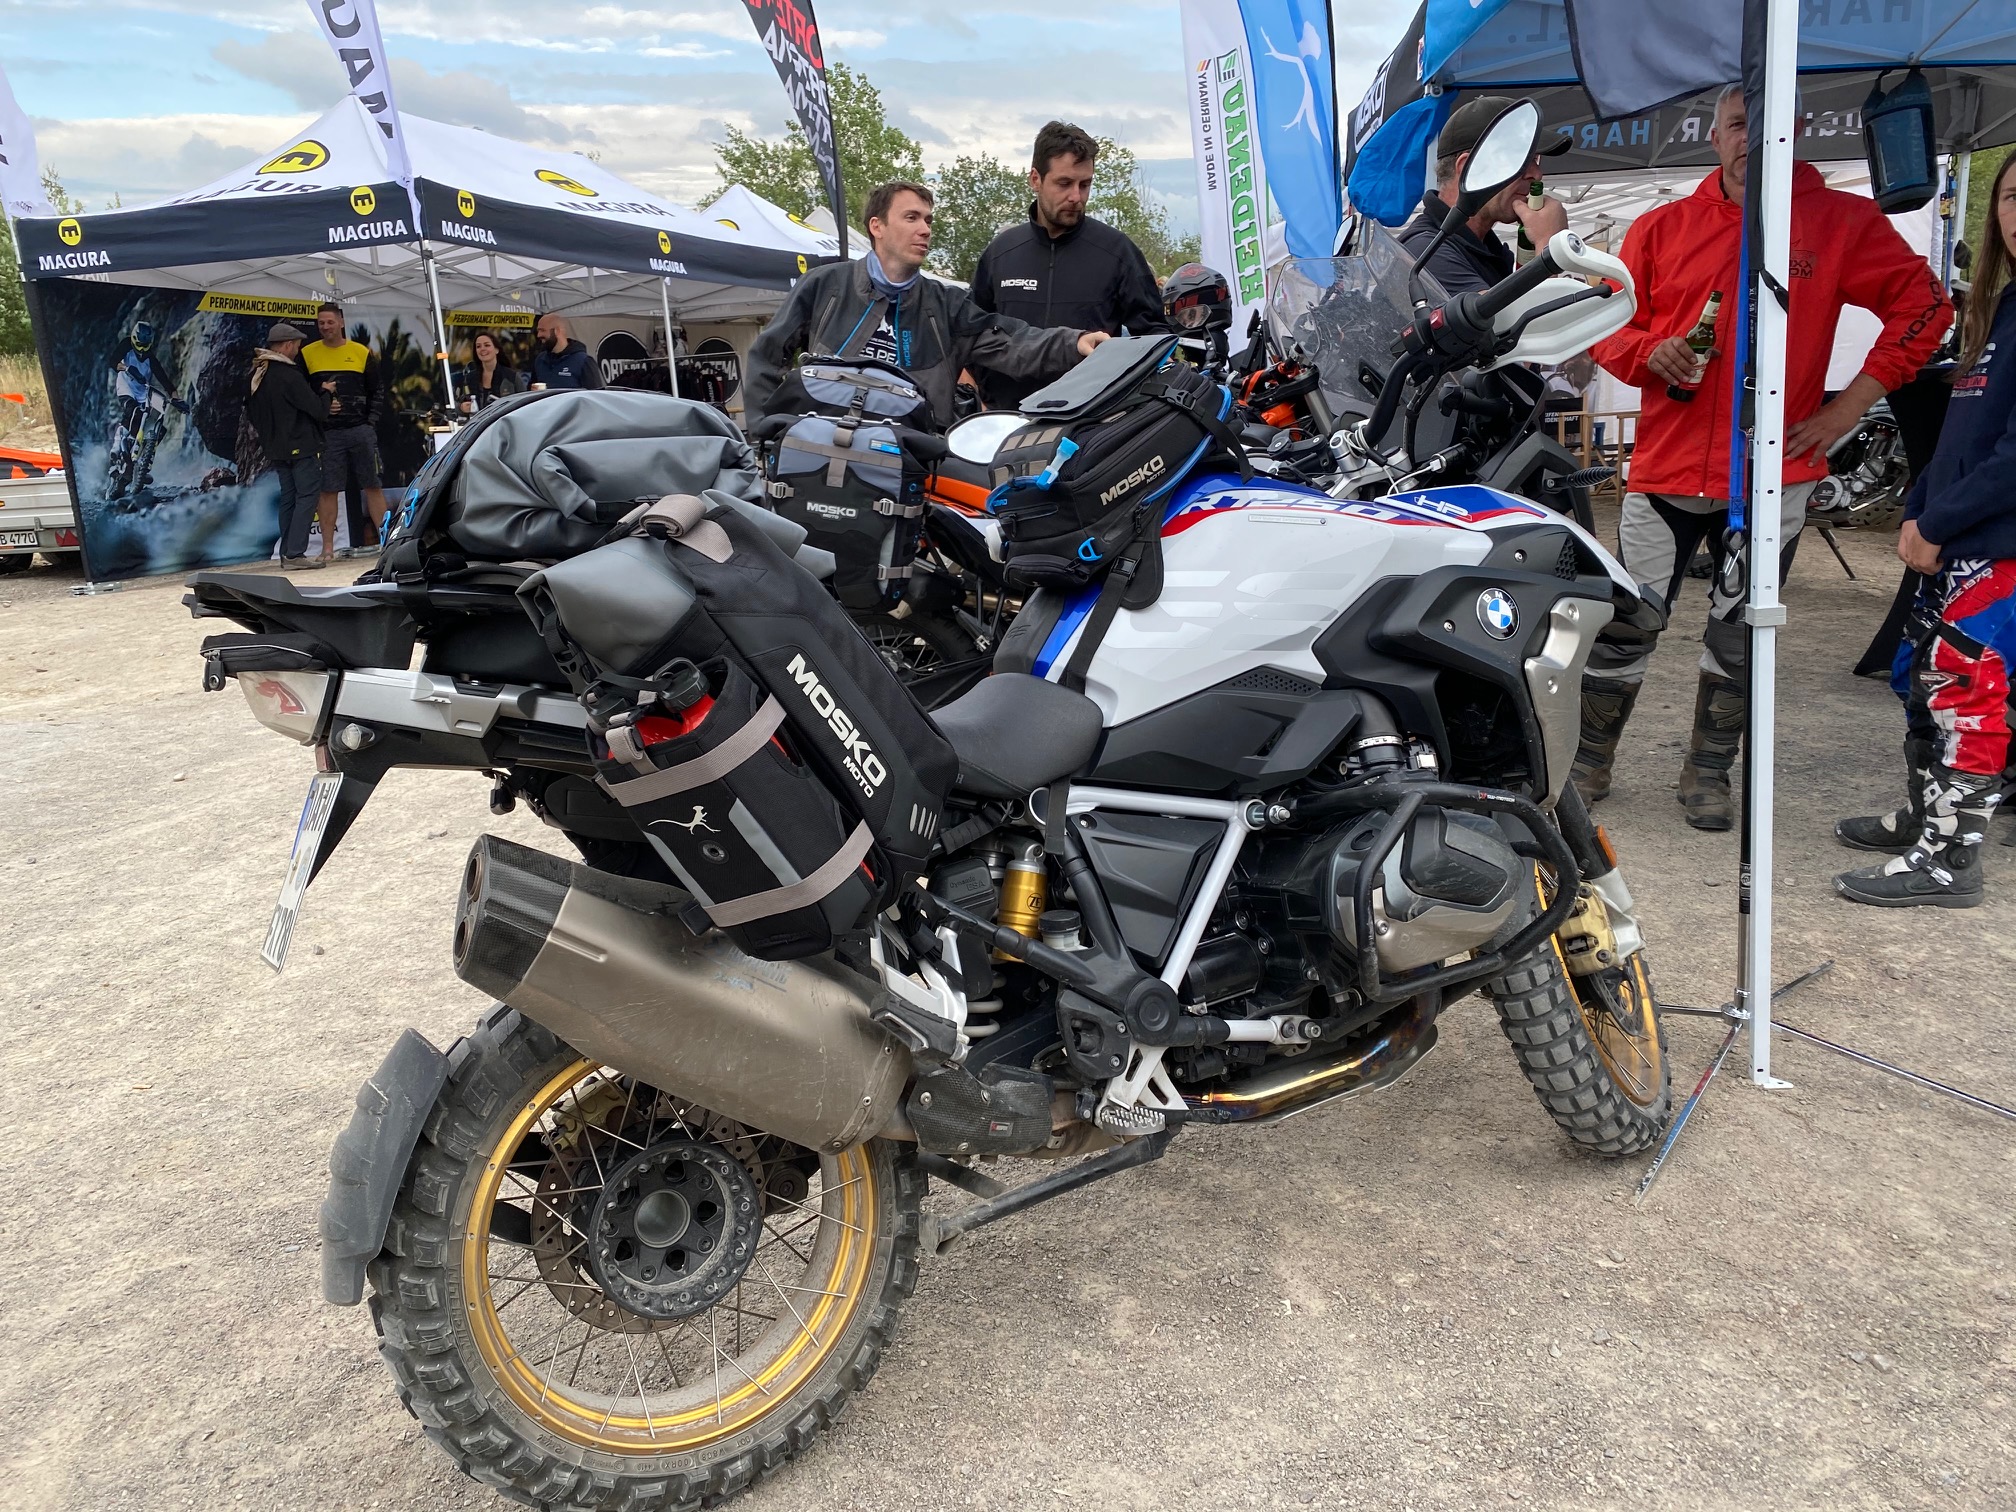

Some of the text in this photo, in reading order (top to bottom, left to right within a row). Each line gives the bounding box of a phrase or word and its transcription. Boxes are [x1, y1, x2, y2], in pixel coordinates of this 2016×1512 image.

[328, 219, 408, 244] MAGURA
[441, 220, 498, 246] MAGURA
[38, 250, 112, 271] MAGURA
[649, 258, 688, 275] MAGURA
[1000, 279, 1038, 288] MOSKO
[209, 296, 316, 316] PERFORMANCE COMPONENTS
[452, 313, 530, 325] PERFORMANCE COMPONENTS
[902, 331, 912, 367] MOSKO
[1100, 455, 1165, 506] MOSKO
[1146, 467, 1167, 485] MOTO
[806, 502, 857, 517] MOSKO
[1414, 495, 1472, 519] HP
[10, 532, 36, 545] 4770
[1964, 567, 1994, 590] 1970
[1482, 590, 1517, 611] BMW
[785, 652, 888, 788] MOSKO
[842, 755, 875, 799] MOTO
[949, 875, 977, 889] Dynamic
[965, 880, 986, 892] ESA
[1029, 896, 1043, 909] ZF
